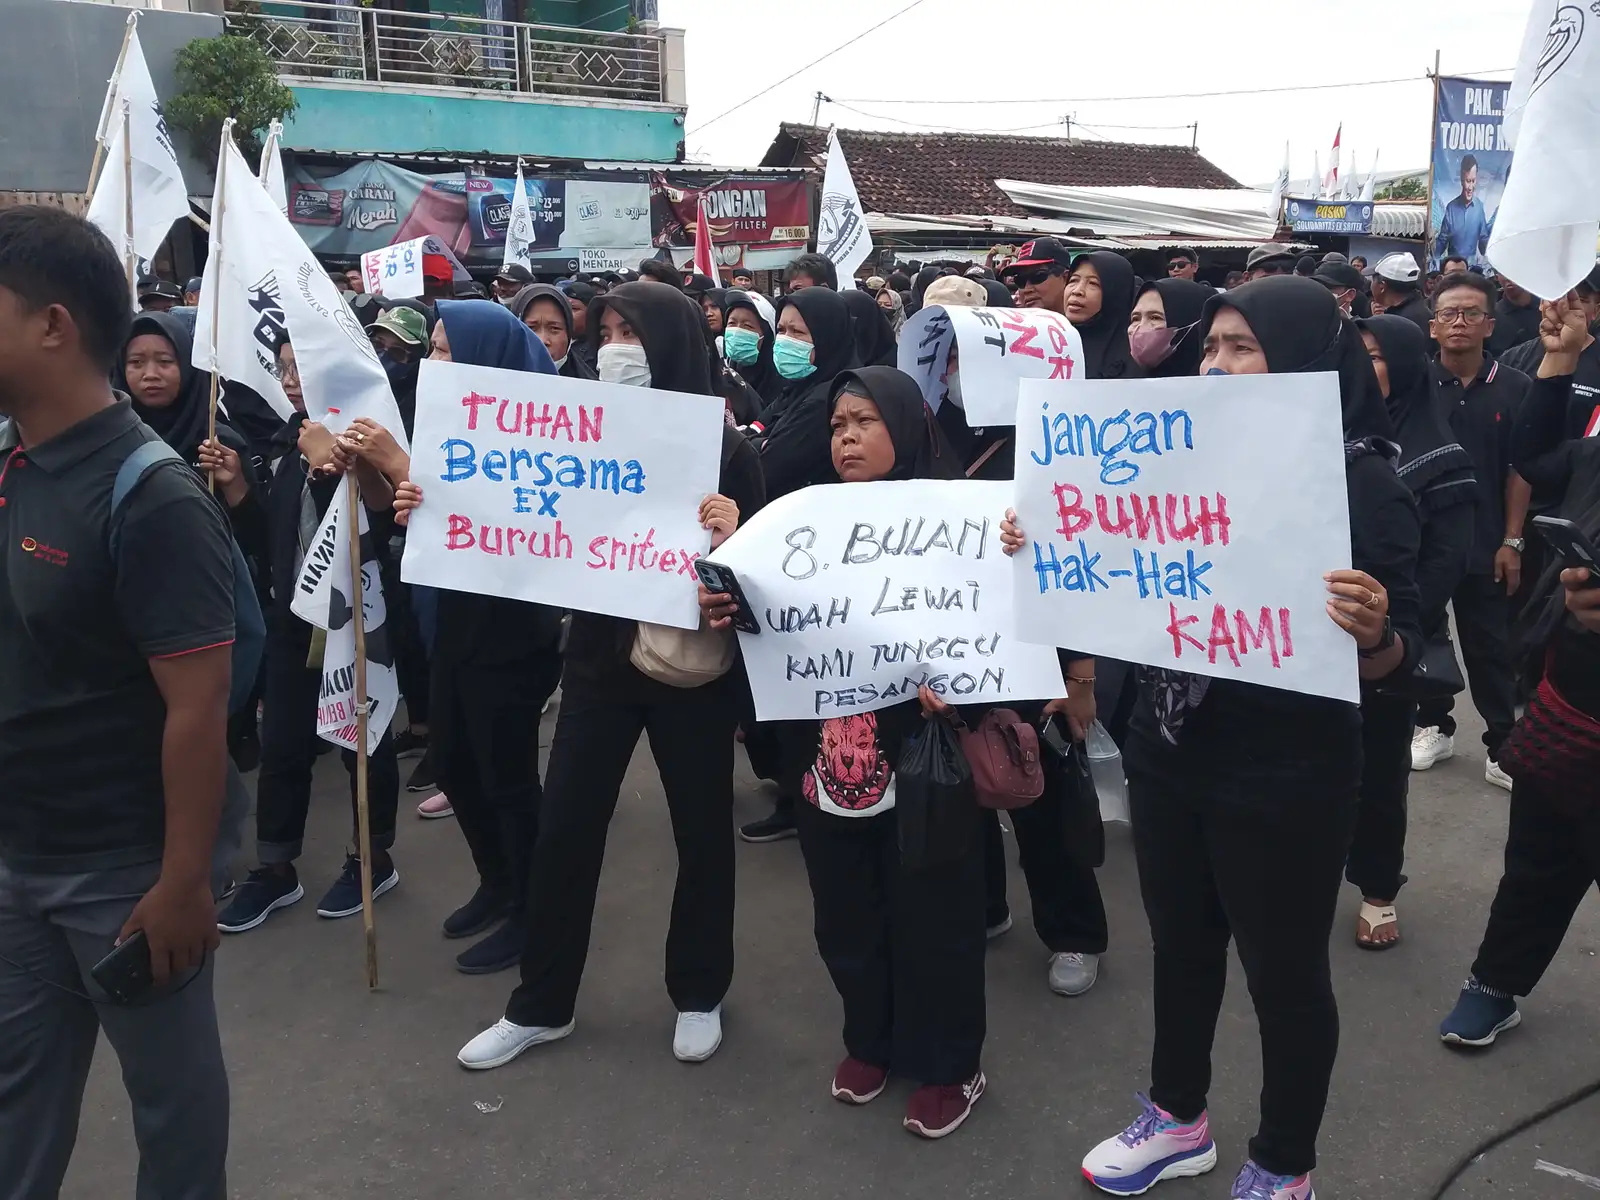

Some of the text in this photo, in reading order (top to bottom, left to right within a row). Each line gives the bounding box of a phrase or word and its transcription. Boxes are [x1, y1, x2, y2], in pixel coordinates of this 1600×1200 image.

[1440, 122, 1493, 151] TOLONG
[348, 189, 395, 200] GARAM
[469, 181, 489, 189] NEW
[347, 202, 396, 228] Merah
[735, 220, 767, 229] FILTER
[1296, 220, 1335, 231] SOLIDARITAS
[1316, 205, 1346, 218] POSKO
[784, 228, 806, 238] 16.000
[582, 250, 606, 259] TOKO
[583, 260, 623, 269] MENTARI
[462, 391, 603, 443] TUHAN
[1030, 401, 1194, 486] jangan
[439, 437, 646, 494] Bersama
[512, 486, 561, 517] EX
[1051, 481, 1231, 546] BUNUH
[444, 513, 702, 581] Buruh sritex
[842, 516, 990, 565] BULAN
[1032, 538, 1213, 600] Hak-Hak
[871, 576, 980, 617] LEWAT
[1165, 601, 1294, 668] KAMI
[786, 632, 1001, 681] KAMI TUNGGU
